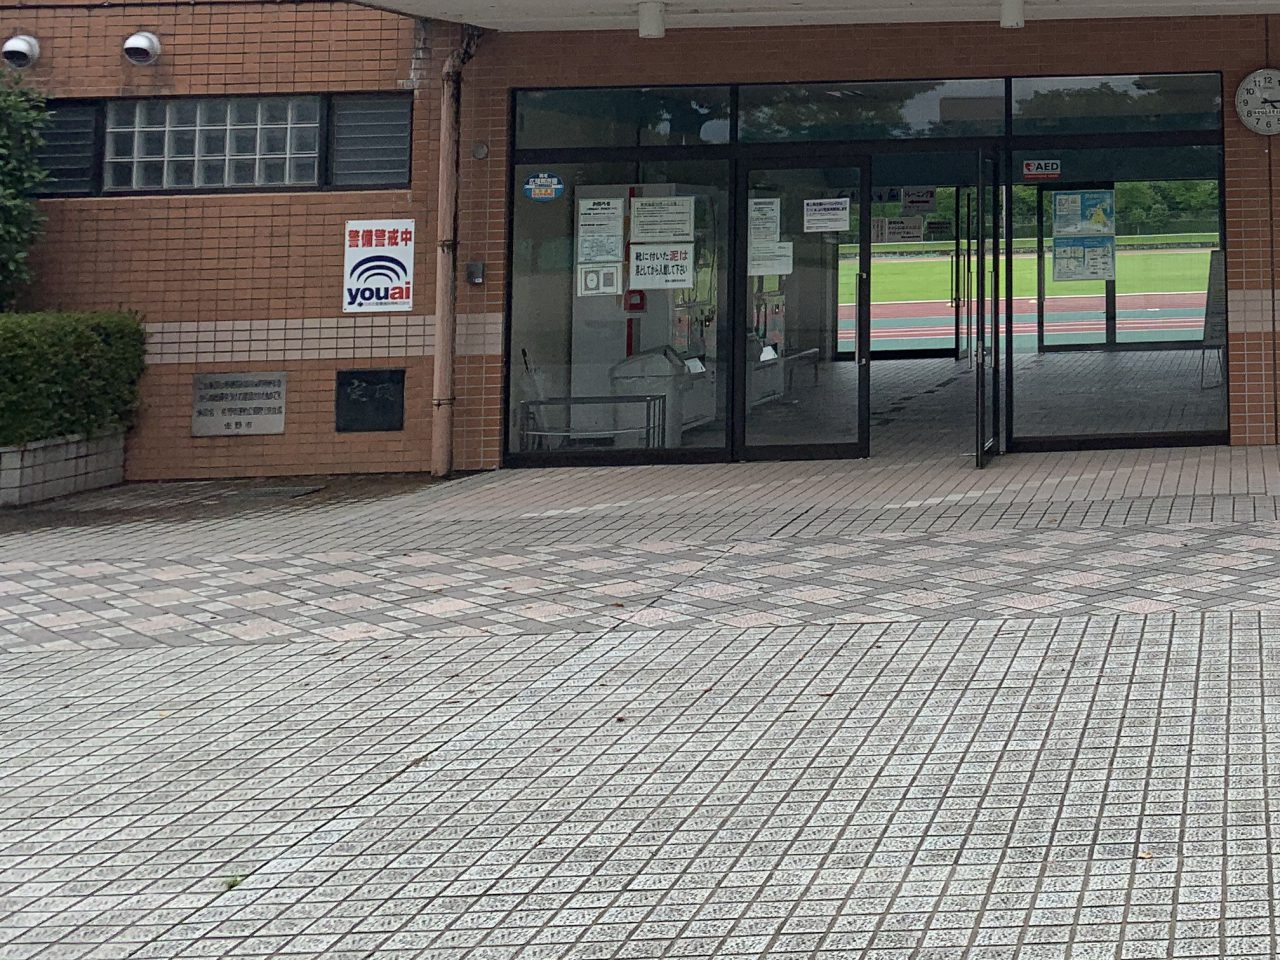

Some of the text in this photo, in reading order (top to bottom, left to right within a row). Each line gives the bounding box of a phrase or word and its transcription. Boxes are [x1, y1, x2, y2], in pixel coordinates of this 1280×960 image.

[1266, 120, 1271, 128] 6
[1035, 162, 1059, 171] AED
[348, 228, 412, 248] 警備警戒中
[635, 249, 689, 262] 靴に付いた泥は
[347, 281, 411, 306] youai
